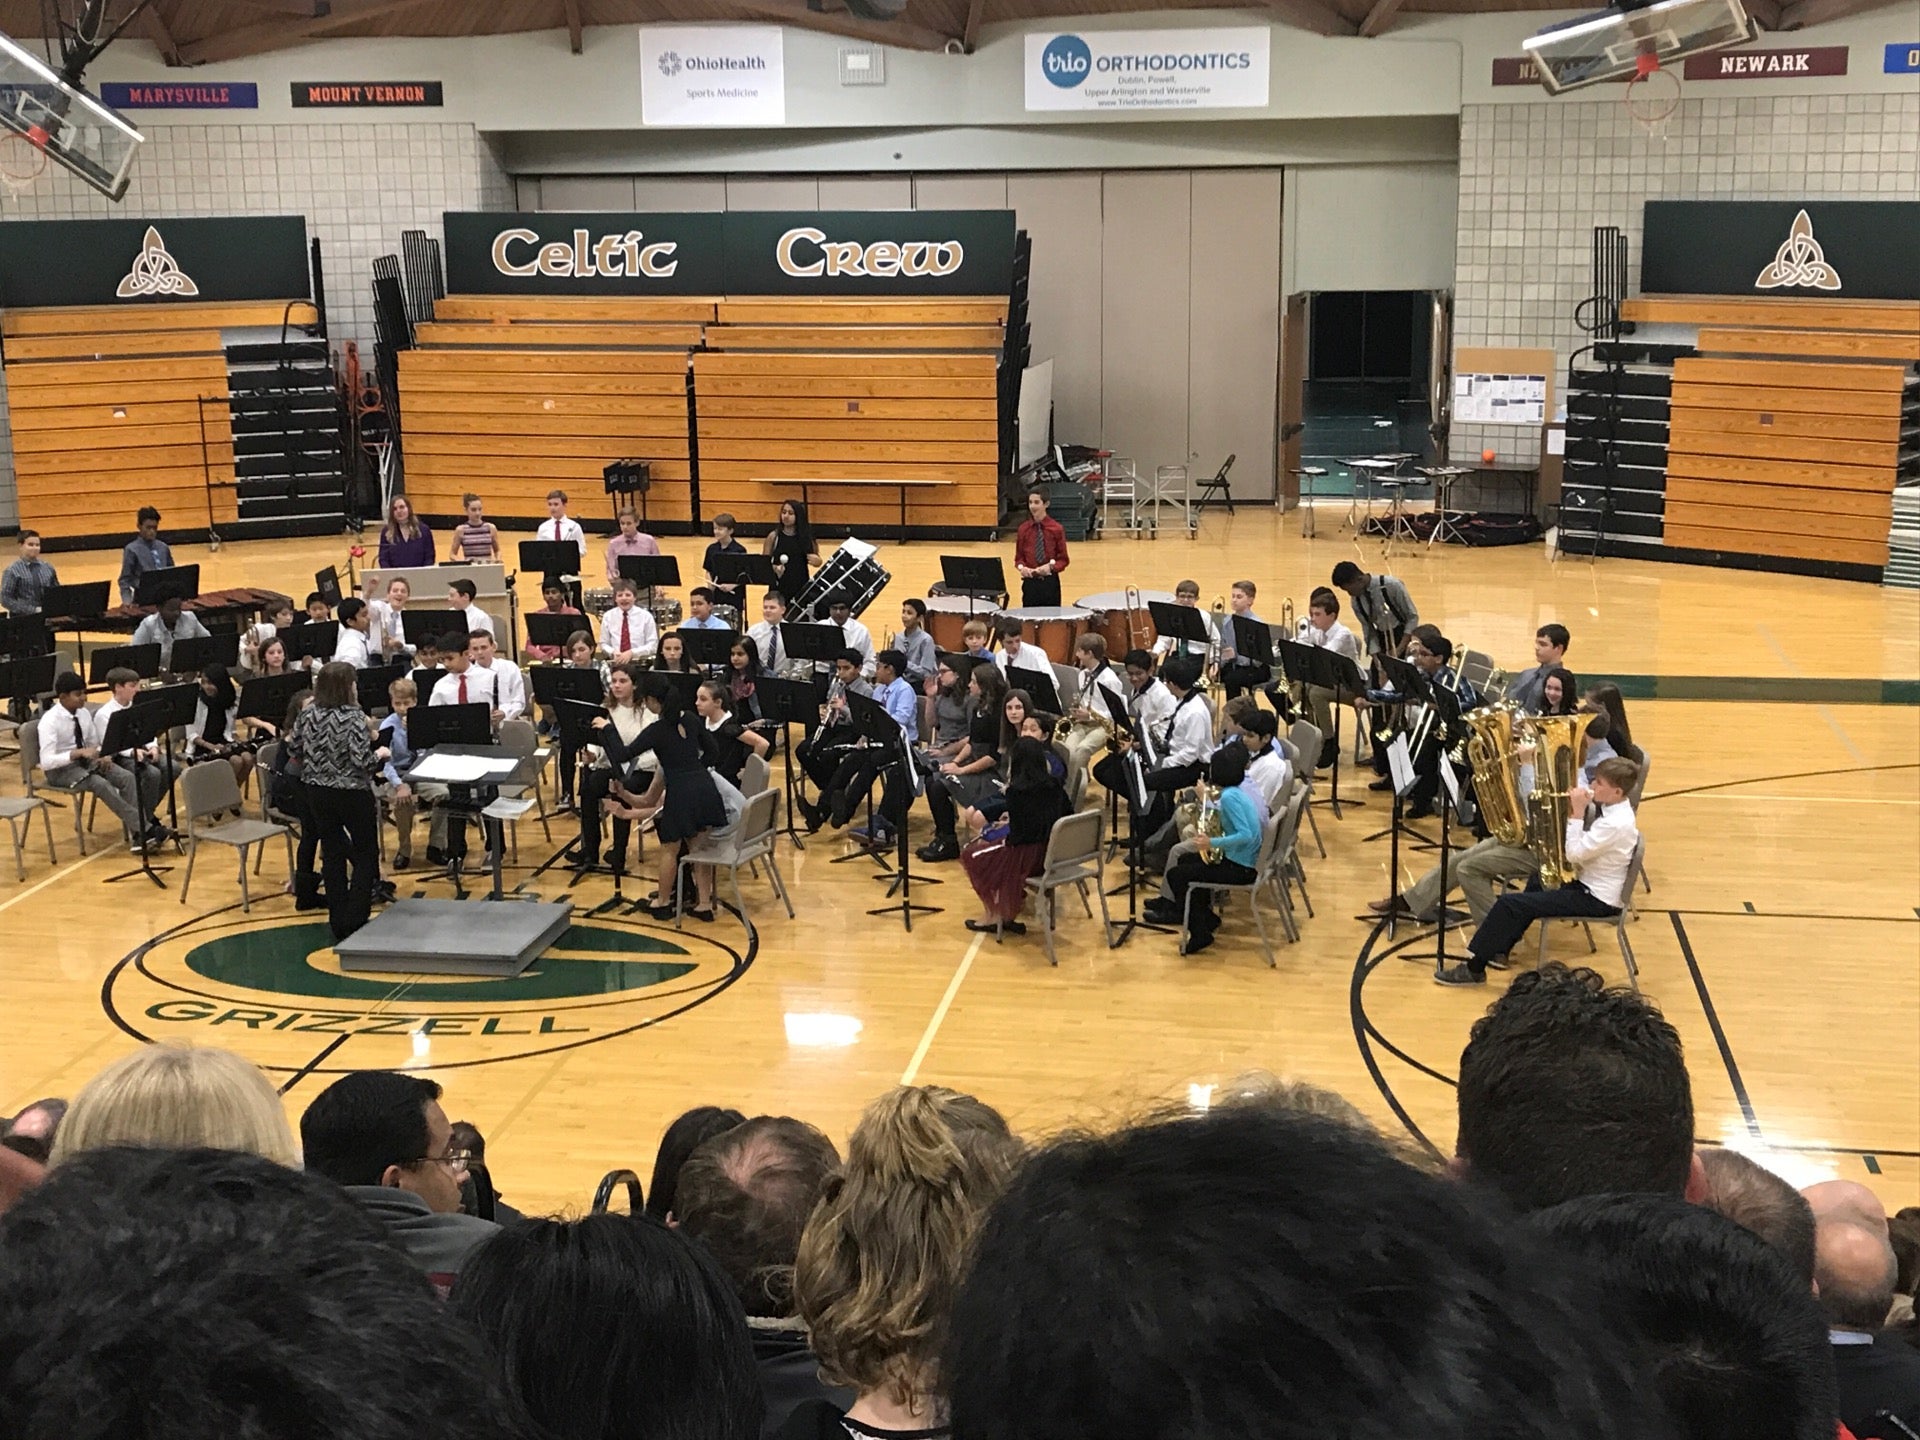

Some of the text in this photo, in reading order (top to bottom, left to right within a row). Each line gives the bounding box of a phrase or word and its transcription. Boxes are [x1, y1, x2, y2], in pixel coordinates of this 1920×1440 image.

[685, 55, 766, 70] OhioHealth
[1047, 52, 1087, 73] trio
[1096, 53, 1250, 72] ORTHODONTICS
[1720, 53, 1811, 74] NEWARK
[129, 87, 229, 102] MARYSVILLE
[308, 85, 424, 103] MOUNT VERNON
[686, 87, 759, 99] Sports Medicine
[1085, 86, 1211, 98] Upper Arlington and Westerville
[492, 227, 963, 278] Celtic Crew
[145, 1000, 590, 1036] GRIZZELL
